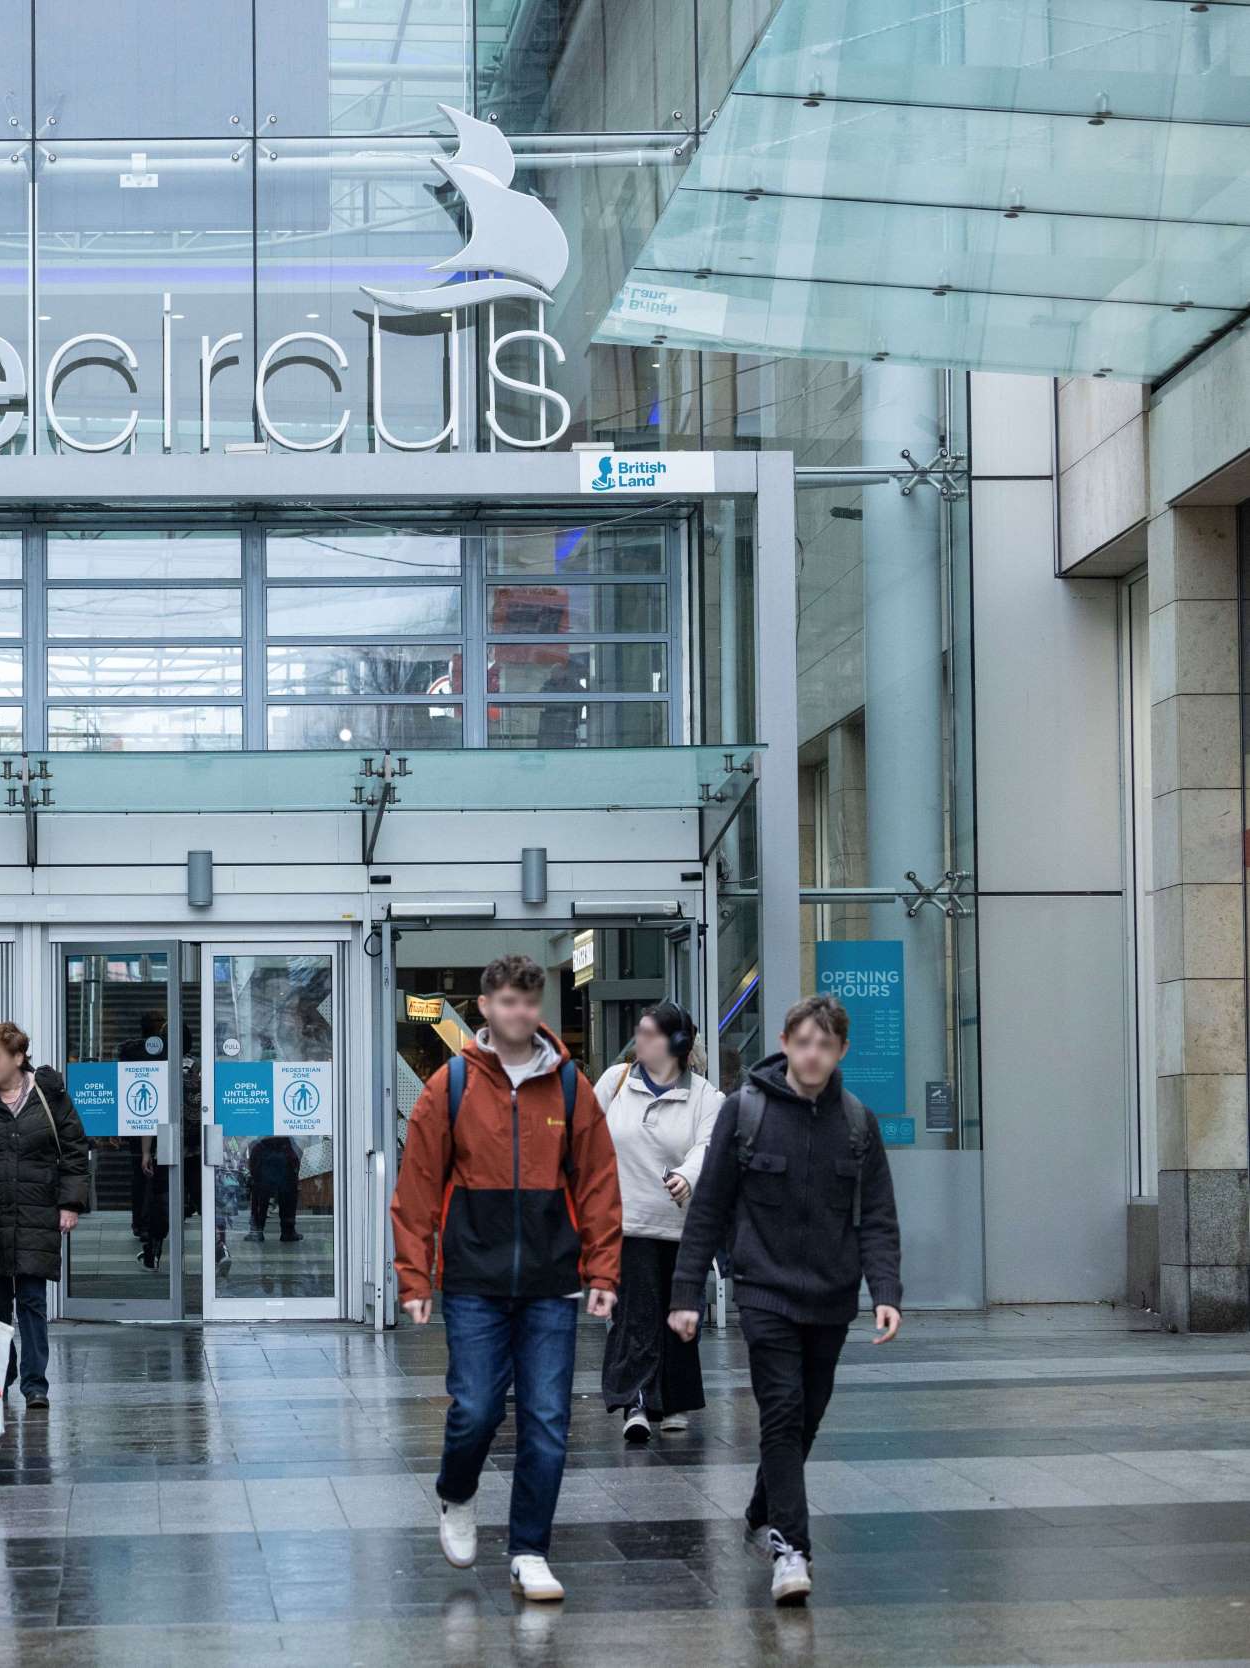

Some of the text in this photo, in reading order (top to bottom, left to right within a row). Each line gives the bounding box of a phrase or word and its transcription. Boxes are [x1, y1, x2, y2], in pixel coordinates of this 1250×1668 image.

[618, 461, 667, 474] British
[618, 475, 656, 487] Land
[821, 970, 899, 984] OPENING
[830, 984, 891, 997] HOURS
